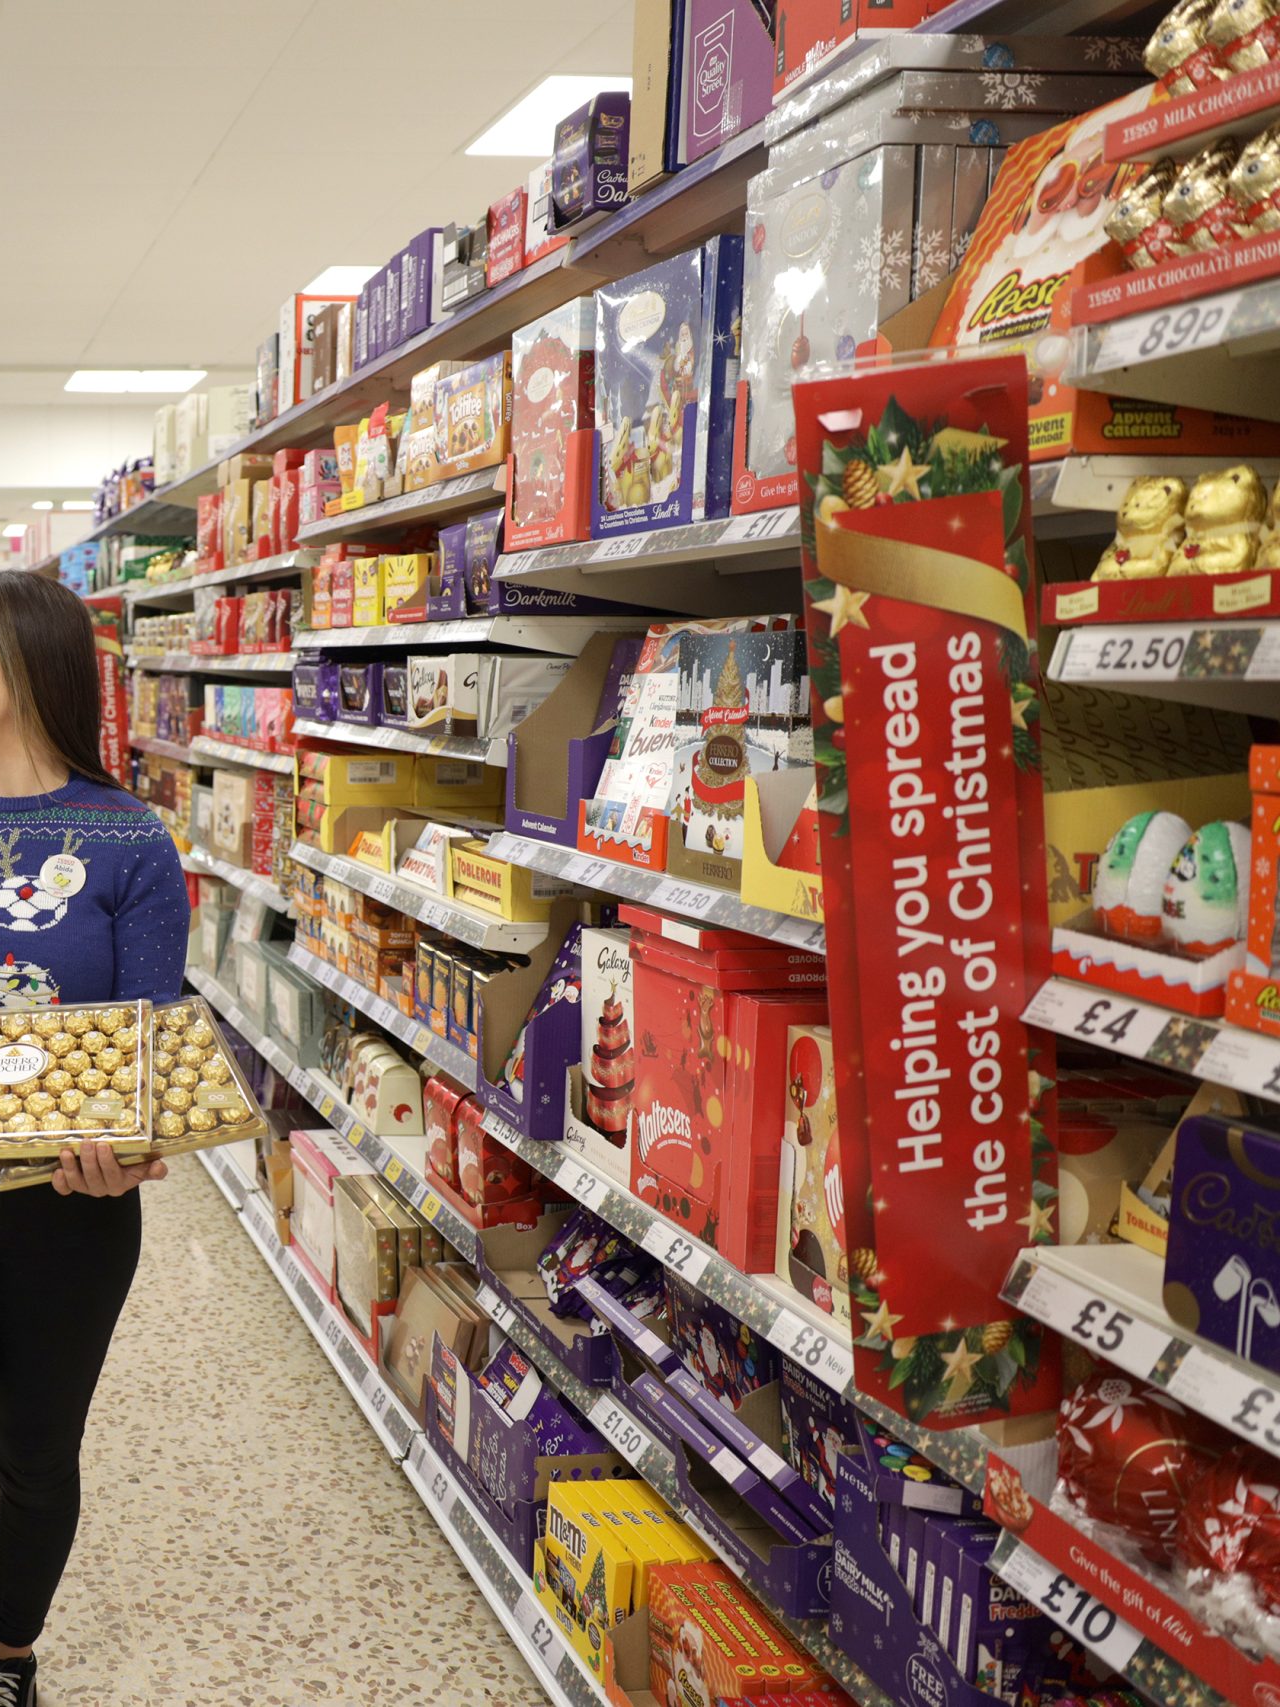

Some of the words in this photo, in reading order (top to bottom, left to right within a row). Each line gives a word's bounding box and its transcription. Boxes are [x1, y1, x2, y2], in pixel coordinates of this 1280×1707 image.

[700, 61, 725, 86] Quality
[702, 78, 724, 98] Street
[784, 61, 806, 85] HANDLE
[1123, 118, 1158, 139] TESCO
[1164, 103, 1197, 129] MILK
[1088, 287, 1121, 303] TESCO
[1126, 275, 1155, 298] MILK
[1157, 253, 1232, 288] CHOCOLATE
[1139, 306, 1223, 356] 89p
[449, 392, 482, 425] Toffifee
[760, 486, 774, 498] Give
[776, 484, 786, 496] the
[787, 482, 798, 496] gift
[624, 508, 645, 518] Chocolates
[629, 515, 648, 524] Christmas
[743, 511, 786, 538] £11
[604, 538, 642, 557] £5.50
[505, 589, 577, 608] Darkmilk
[1096, 637, 1184, 669] £2.50
[104, 654, 116, 718] Christmas
[413, 669, 436, 694] Galaxy
[704, 711, 722, 724] Advent
[724, 709, 747, 722] Calendar
[869, 641, 936, 838] spread
[709, 758, 738, 768] COLLECTION
[943, 631, 993, 921] Christmas
[522, 818, 538, 830] Advent
[538, 822, 557, 834] Calendar
[504, 845, 527, 861] £5
[457, 856, 501, 889] TOBLERONE
[580, 864, 603, 881] £7
[702, 862, 733, 880] FERRERO
[665, 887, 711, 910] £12.50
[893, 855, 944, 957] you
[597, 946, 632, 983] Galaxy
[950, 938, 997, 992] of
[1074, 999, 1138, 1044] £4
[890, 966, 951, 1173] Helping
[957, 1005, 1004, 1124] cost
[566, 1126, 586, 1150] Galaxy
[638, 1100, 692, 1162] Maltesers
[572, 1172, 596, 1198] £2
[964, 1139, 1008, 1232] the
[516, 1222, 533, 1231] Box
[664, 1237, 694, 1272] £2
[491, 1302, 506, 1321] £1
[1071, 1300, 1134, 1350] £5
[790, 1326, 828, 1366] £8
[826, 1354, 846, 1375] New
[783, 1358, 806, 1384] DAIRY
[806, 1378, 826, 1402] MILK
[370, 1389, 384, 1412] £8
[601, 1410, 642, 1452] £1.50
[432, 1472, 448, 1502] £3
[550, 1504, 587, 1560] m&m's
[835, 1550, 866, 1582] DAIRY
[862, 1572, 886, 1602] MILK
[1041, 1574, 1117, 1644] £10
[1069, 1546, 1098, 1578] Give
[1100, 1565, 1121, 1593] the
[1123, 1584, 1144, 1611] gift
[1146, 1601, 1161, 1622] of
[1162, 1616, 1193, 1647] bliss
[530, 1619, 553, 1656] £2
[911, 1658, 944, 1698] FREE
